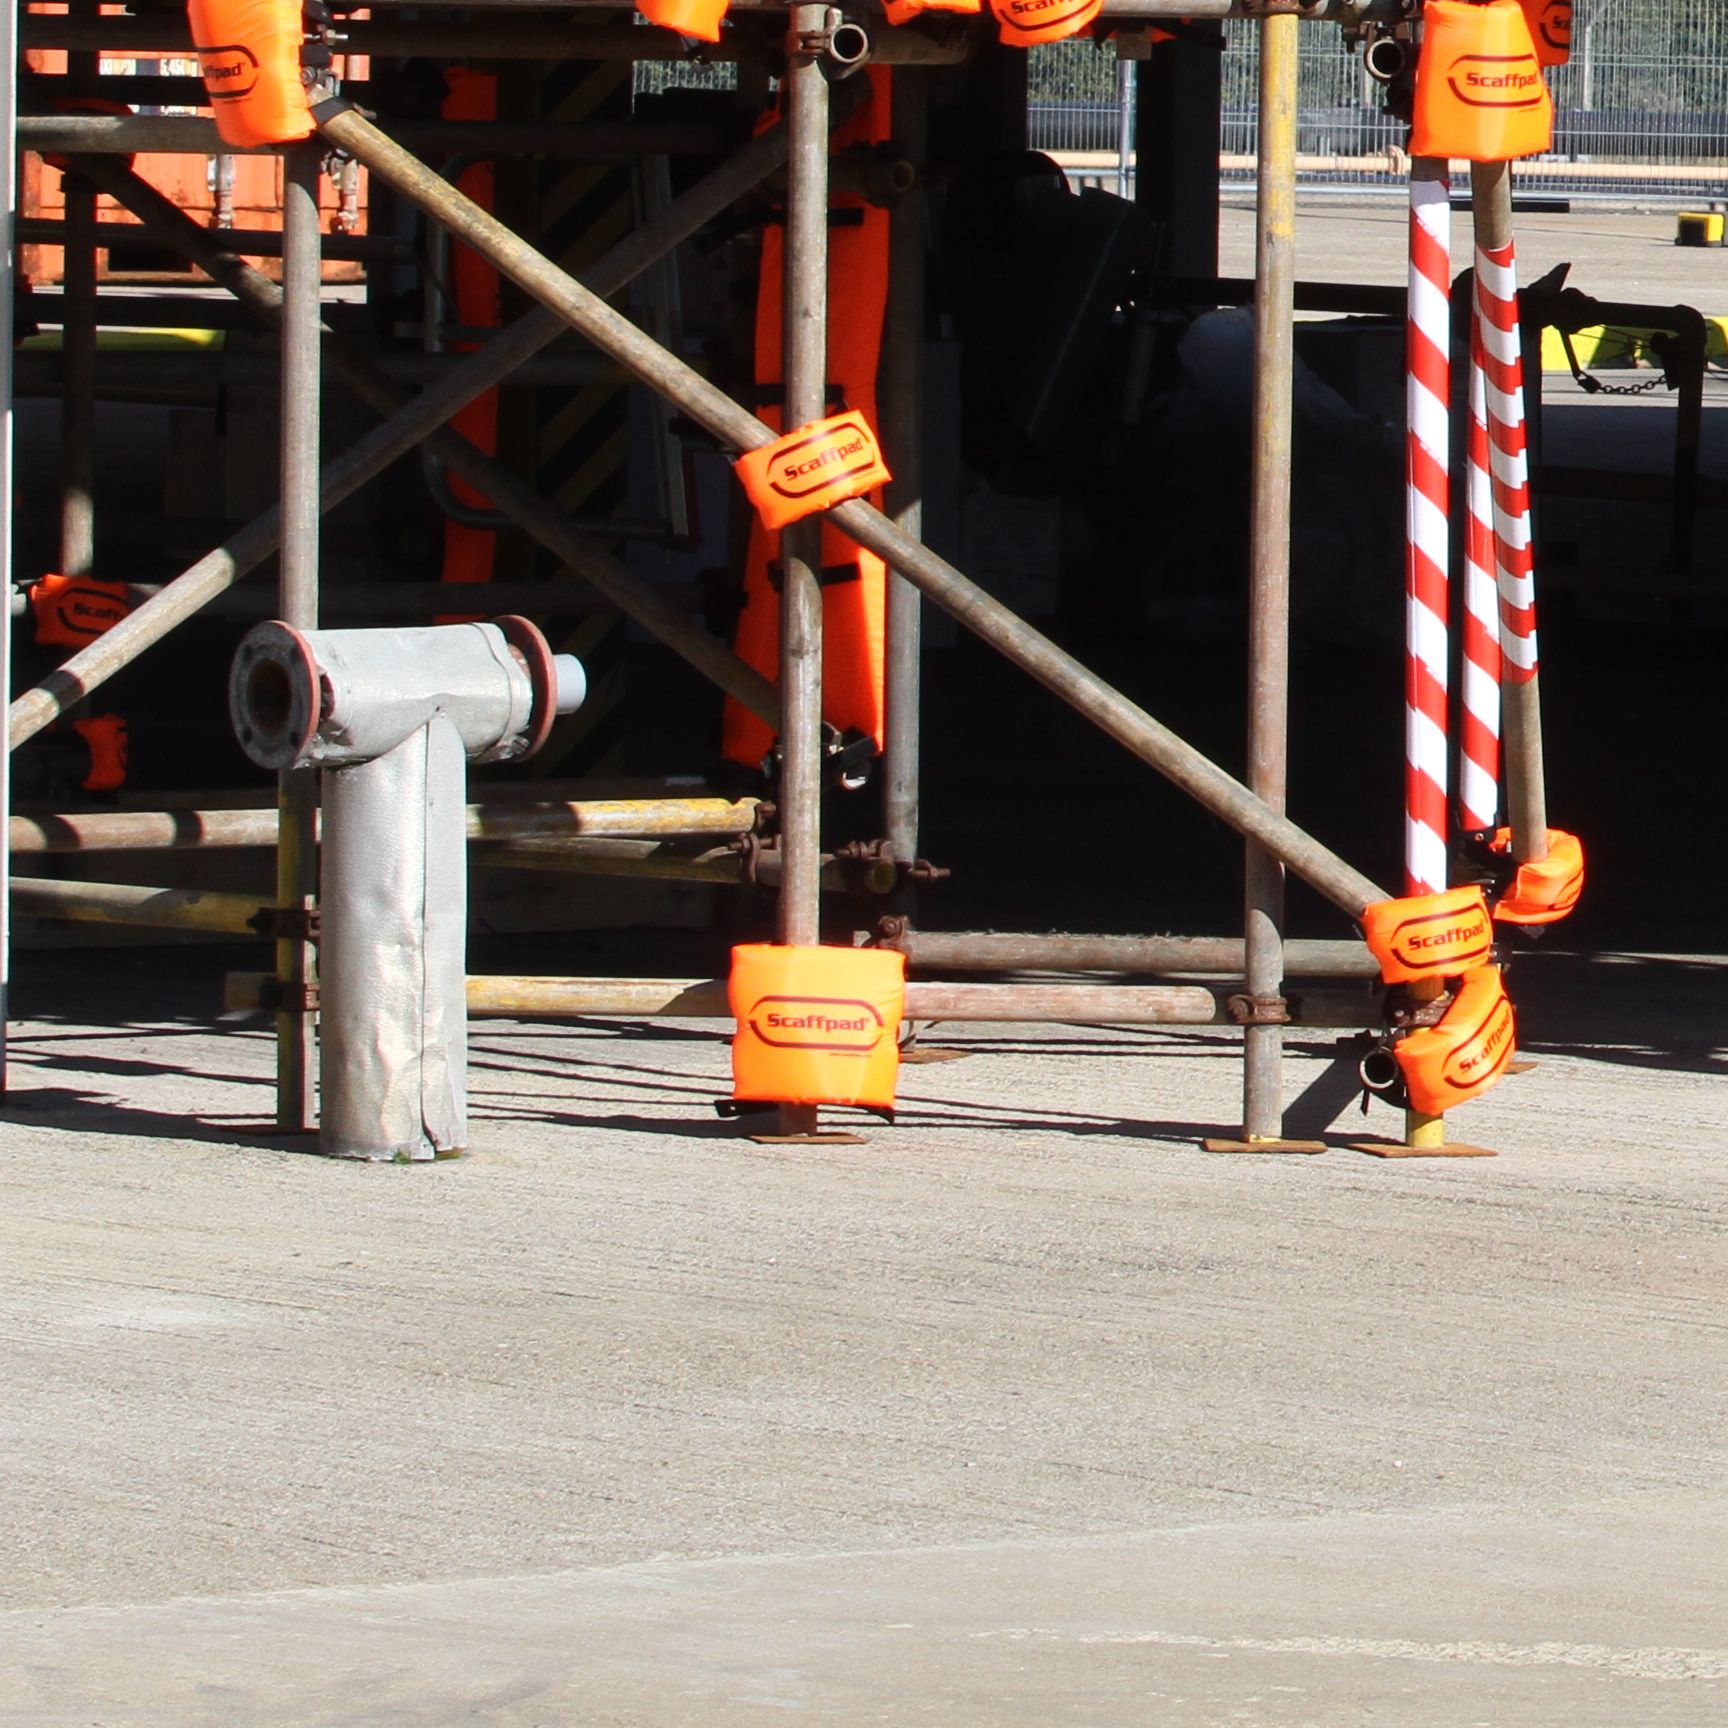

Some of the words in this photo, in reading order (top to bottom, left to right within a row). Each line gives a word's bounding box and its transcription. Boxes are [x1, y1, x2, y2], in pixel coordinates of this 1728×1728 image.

[783, 436, 863, 482] Scaffpad
[1407, 920, 1485, 950] Scaffpad
[767, 1012, 866, 1033] Scaffpad
[1459, 1008, 1512, 1073] Scaffpad
